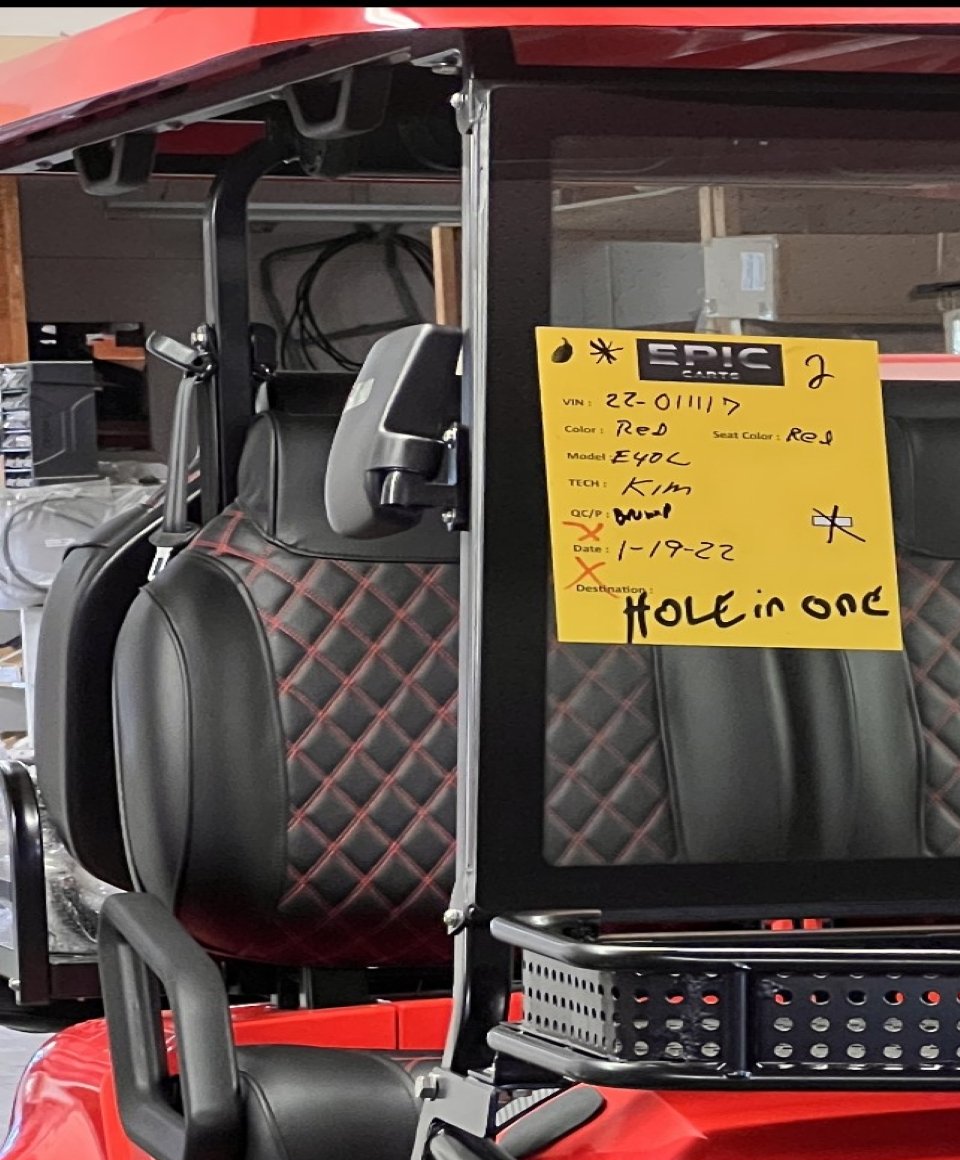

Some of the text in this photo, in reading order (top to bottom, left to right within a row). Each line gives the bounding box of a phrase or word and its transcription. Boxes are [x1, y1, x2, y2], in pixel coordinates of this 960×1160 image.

[647, 343, 772, 369] EPIC
[682, 370, 740, 380] CARTS
[712, 430, 739, 439] Seat
[618, 540, 735, 562] 1-19-22
[624, 590, 746, 643] HOLE
[754, 589, 785, 617] in
